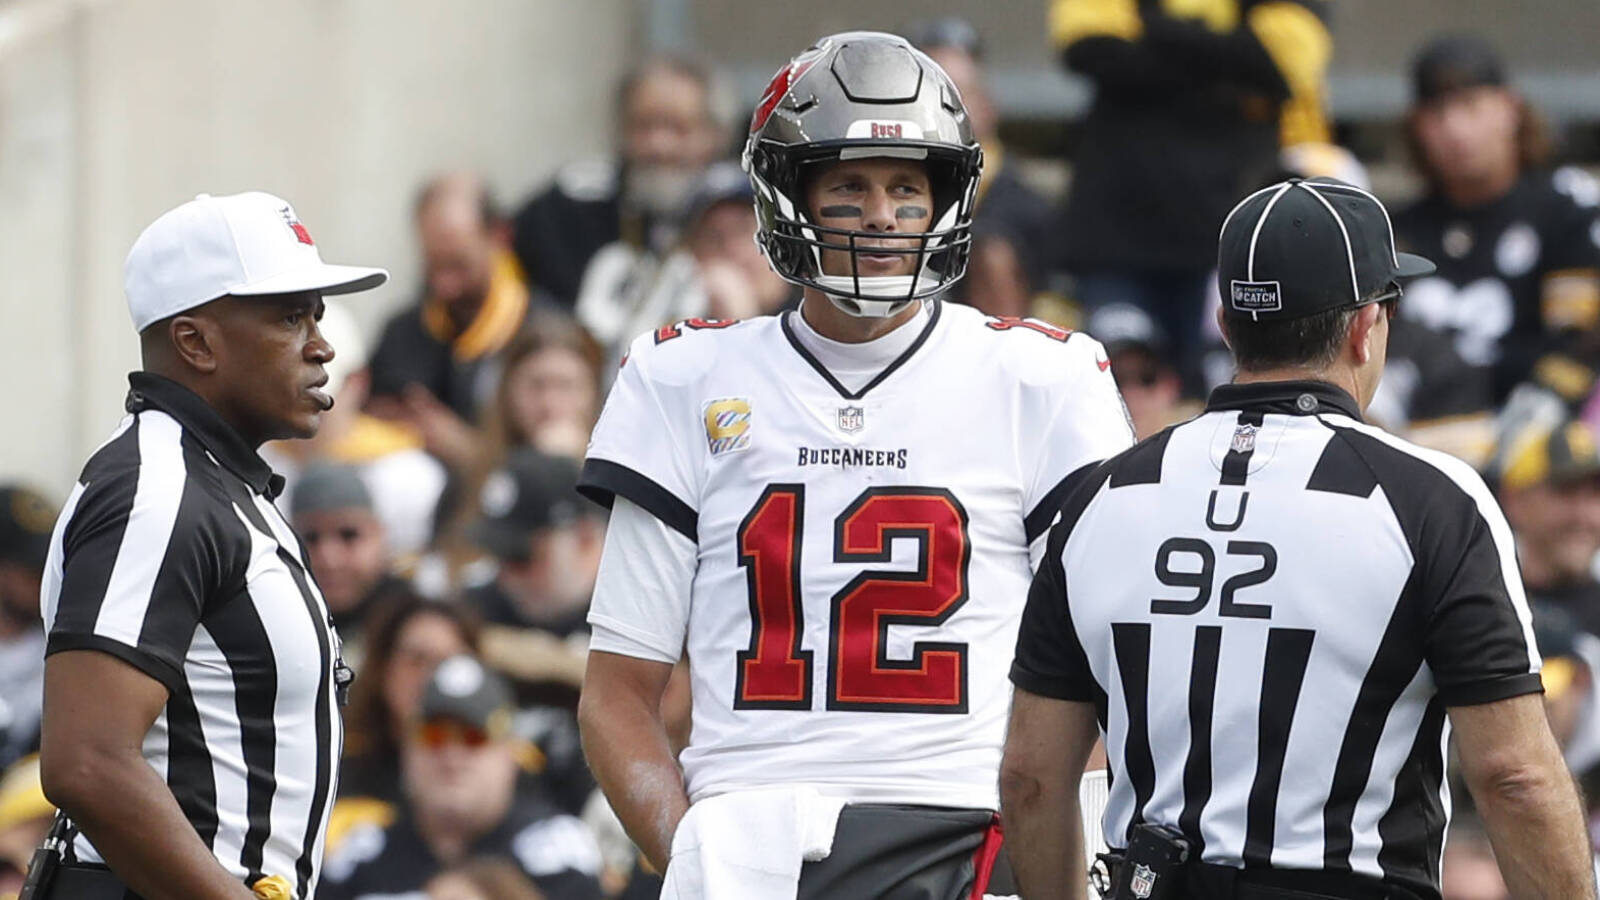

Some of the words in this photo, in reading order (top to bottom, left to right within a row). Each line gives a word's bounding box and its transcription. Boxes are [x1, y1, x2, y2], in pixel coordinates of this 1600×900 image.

[1244, 292, 1276, 302] CATCH
[798, 447, 907, 470] BUCCANEERS
[1206, 490, 1250, 532] U
[733, 483, 970, 714] 12
[1150, 537, 1278, 620] 92
